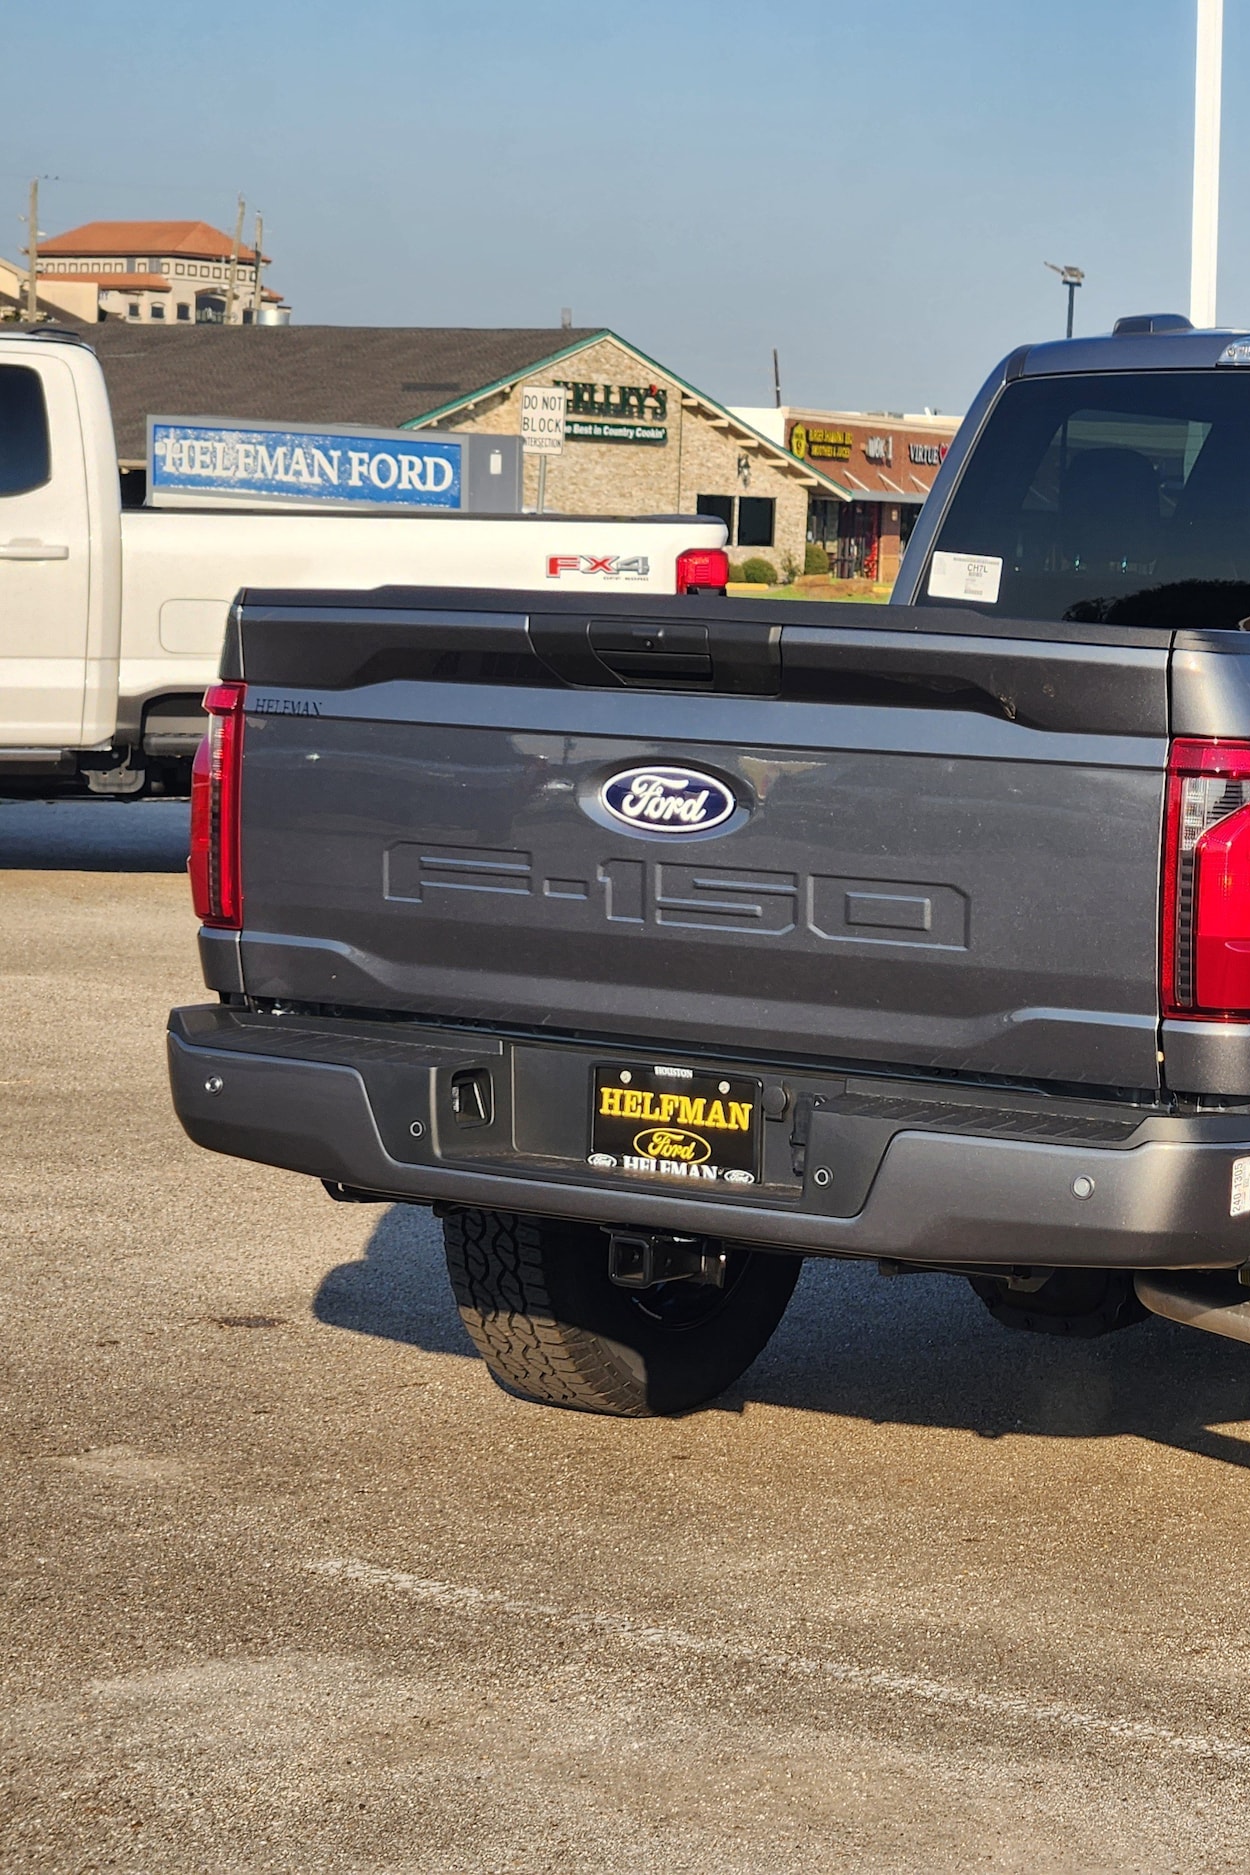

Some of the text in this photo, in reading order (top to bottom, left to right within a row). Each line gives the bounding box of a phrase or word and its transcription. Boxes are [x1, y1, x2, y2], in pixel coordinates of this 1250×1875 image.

[524, 395, 562, 411] DO NOT
[523, 416, 561, 433] BLOCK
[573, 423, 592, 435] Best
[594, 424, 602, 435] in
[603, 425, 634, 439] Country
[162, 436, 454, 492] HELFMAN FORD
[908, 442, 939, 465] VIRTUE
[546, 555, 650, 578] FX4
[967, 563, 989, 573] CH7L
[255, 698, 323, 716] HELFMAN
[621, 773, 706, 824] Ford
[383, 841, 972, 951] F-150
[654, 1066, 693, 1079] HOUSTON
[599, 1087, 753, 1132] HELFMAN
[648, 1131, 697, 1161] Ford
[622, 1155, 719, 1181] HELFMAN
